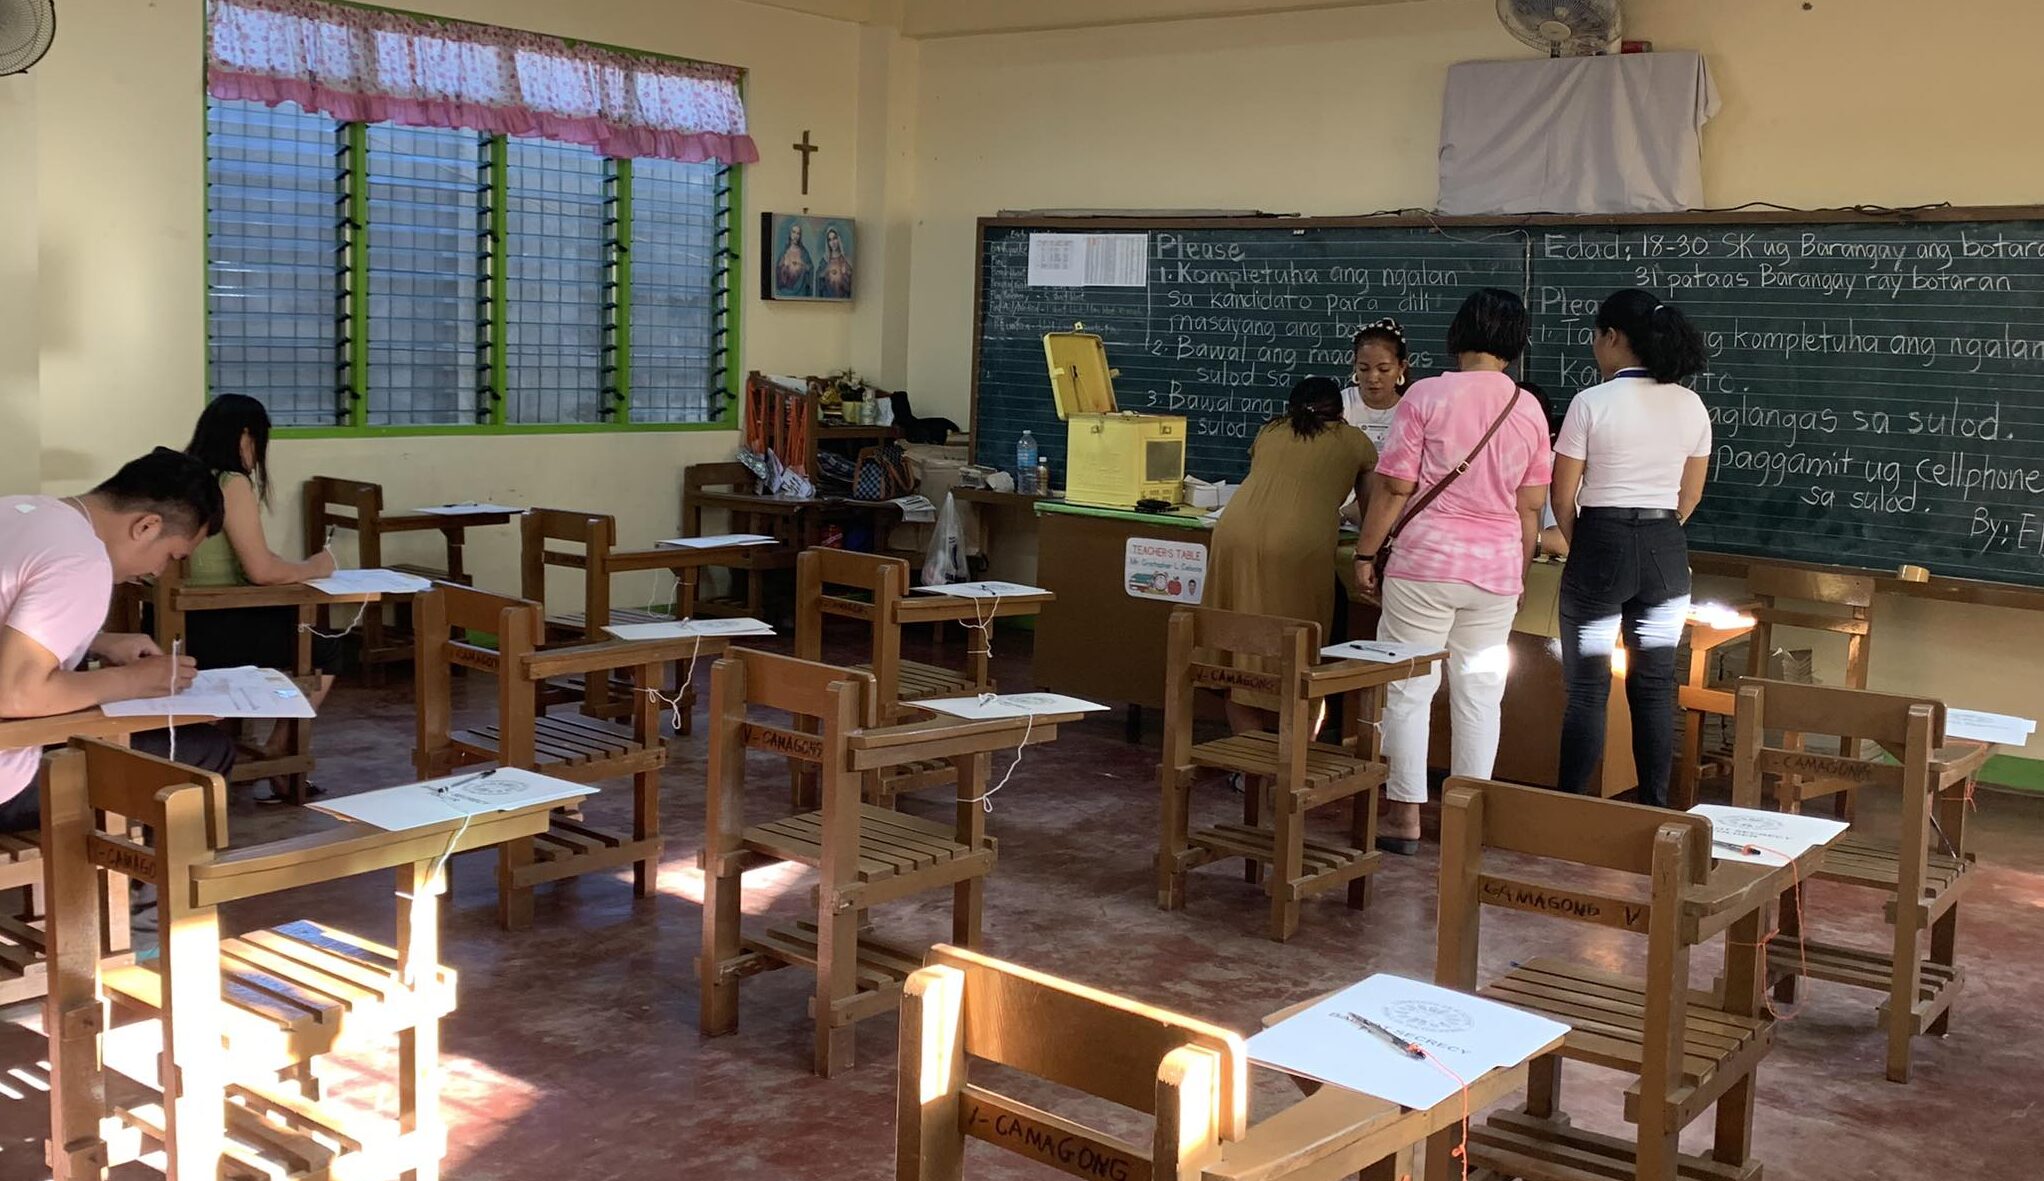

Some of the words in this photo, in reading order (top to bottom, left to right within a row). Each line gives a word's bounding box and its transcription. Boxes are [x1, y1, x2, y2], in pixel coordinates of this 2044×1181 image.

[1157, 234, 1246, 261] Please
[1642, 233, 1709, 258] 18-30
[1721, 233, 1755, 259] SK
[1763, 241, 1791, 267] ug
[1801, 233, 1906, 272] Barangay
[1916, 242, 1953, 270] ang
[1177, 260, 1318, 290] Kompletuha
[1329, 265, 1369, 295] ang
[1382, 261, 1458, 293] ngalan
[1667, 263, 1750, 299] pataas
[1759, 263, 1857, 300] Barangay
[1866, 275, 1903, 299] ray
[1912, 265, 2011, 292] botaran
[1327, 293, 1378, 316] para
[1398, 291, 1430, 312] dili
[1540, 286, 1599, 316] Plea
[1169, 314, 1276, 341] masayang
[1286, 318, 1323, 347] ang
[1734, 317, 1879, 360] kompletuha
[1890, 334, 1935, 367] ang
[1177, 336, 1247, 361] Bawal
[1257, 348, 1297, 372] ang
[1196, 362, 1256, 387] sulod
[1267, 369, 1290, 387] sa
[1169, 380, 1235, 412] Bawal
[1240, 397, 1274, 422] ang
[1197, 416, 1247, 438] sulod
[1709, 395, 1838, 448] aglangas
[1853, 408, 1889, 434] sa
[1907, 397, 2014, 441] sulod.
[1713, 444, 1853, 487] paggamit
[1865, 461, 1900, 493] ug
[1800, 485, 1836, 511] sa
[1175, 549, 1202, 562] TABLE
[1624, 905, 1642, 926] V
